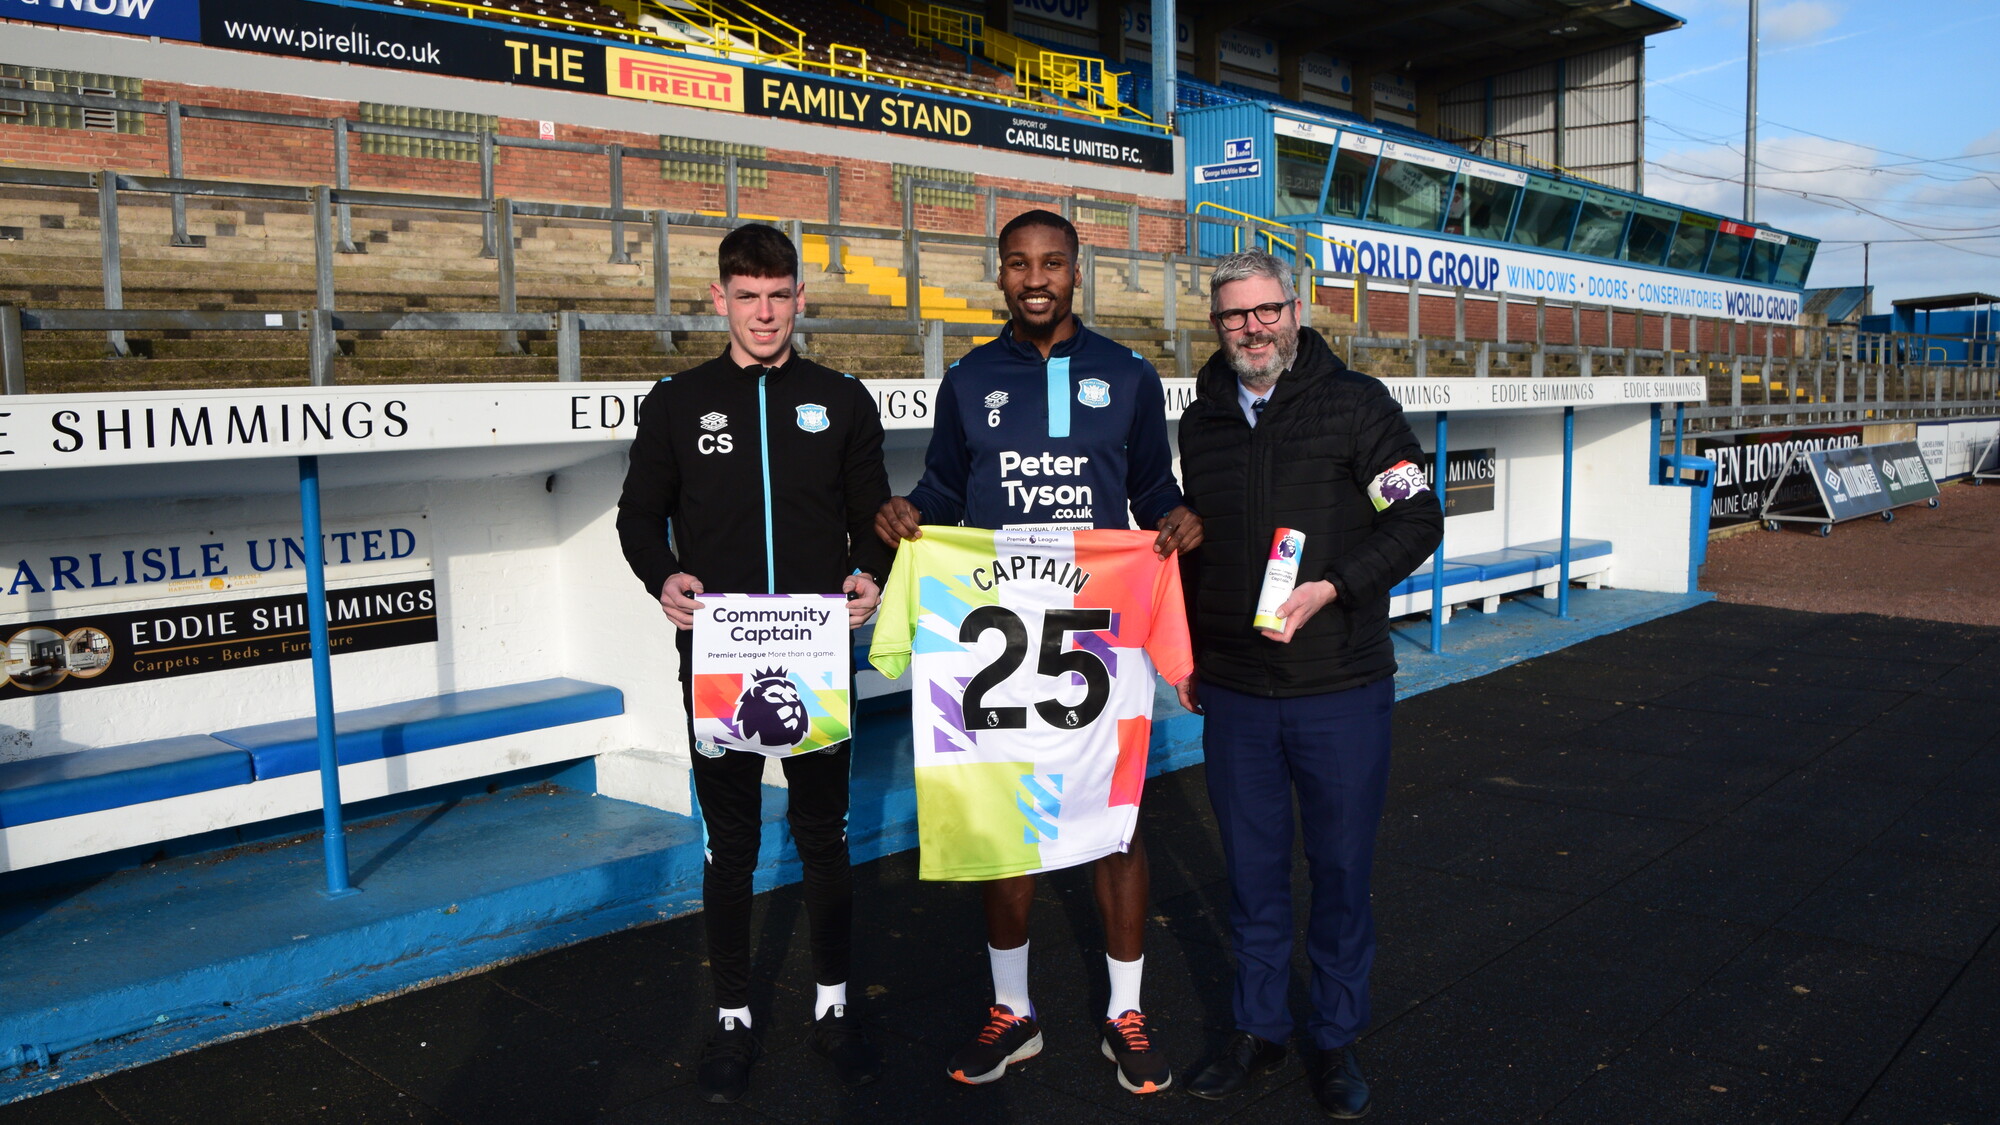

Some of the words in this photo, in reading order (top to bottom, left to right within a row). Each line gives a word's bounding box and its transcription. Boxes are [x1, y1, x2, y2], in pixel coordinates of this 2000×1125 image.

[1012, 0, 1089, 20] ROUP
[1137, 13, 1189, 43] STD
[224, 20, 441, 65] www.pirelli.co.uk
[1221, 39, 1262, 59] WINDOWS
[1308, 63, 1332, 78] DOORS
[504, 39, 585, 84] THE
[618, 57, 733, 103] PIRELLI
[762, 78, 871, 122] FAMILY
[880, 97, 972, 137] STAND
[1012, 117, 1038, 129] SUPPORT
[1039, 122, 1048, 130] OF
[1005, 128, 1070, 153] CARLISLE
[1073, 139, 1119, 159] UNITED
[1122, 147, 1143, 163] F.C.
[1204, 169, 1220, 178] George
[1329, 236, 1422, 280] WORLD
[1429, 250, 1500, 291] GROUP
[1506, 264, 1576, 294] WINDOWS
[1588, 275, 1628, 300] DOORS
[1638, 282, 1722, 311] CONSERVATORIES
[1725, 290, 1764, 318] WORLD
[1767, 295, 1798, 321] GROUP
[1391, 385, 1451, 405] MMINGS
[1492, 384, 1528, 403] EDDIE
[1532, 383, 1594, 402] SHIMMINGS
[1624, 382, 1651, 399] EDDIE
[1654, 382, 1701, 398] SHIMMINGS
[51, 400, 409, 453] SHIMMINGS
[988, 408, 1001, 427] 6
[698, 433, 734, 455] CS
[999, 450, 1089, 478] Peter
[1421, 457, 1495, 485] IMINGS
[1001, 480, 1093, 513] Tyson
[1711, 494, 1739, 516] NLINE
[1741, 492, 1758, 511] CAR
[1052, 506, 1093, 519] .co.uk
[0, 543, 228, 595] ARLISLE
[972, 555, 1090, 595] CAPTAIN
[1268, 572, 1293, 581] Community
[131, 611, 237, 646] EDDIE
[252, 590, 434, 631] SHIMINGS
[712, 606, 831, 626] Community
[730, 624, 812, 645] Captain
[133, 655, 200, 673] Carpets
[222, 647, 260, 662] Beds
[281, 636, 353, 654] Furure
[738, 651, 766, 659] League
[788, 650, 804, 658] than
[813, 650, 836, 658] game.
[958, 605, 1112, 732] 25
